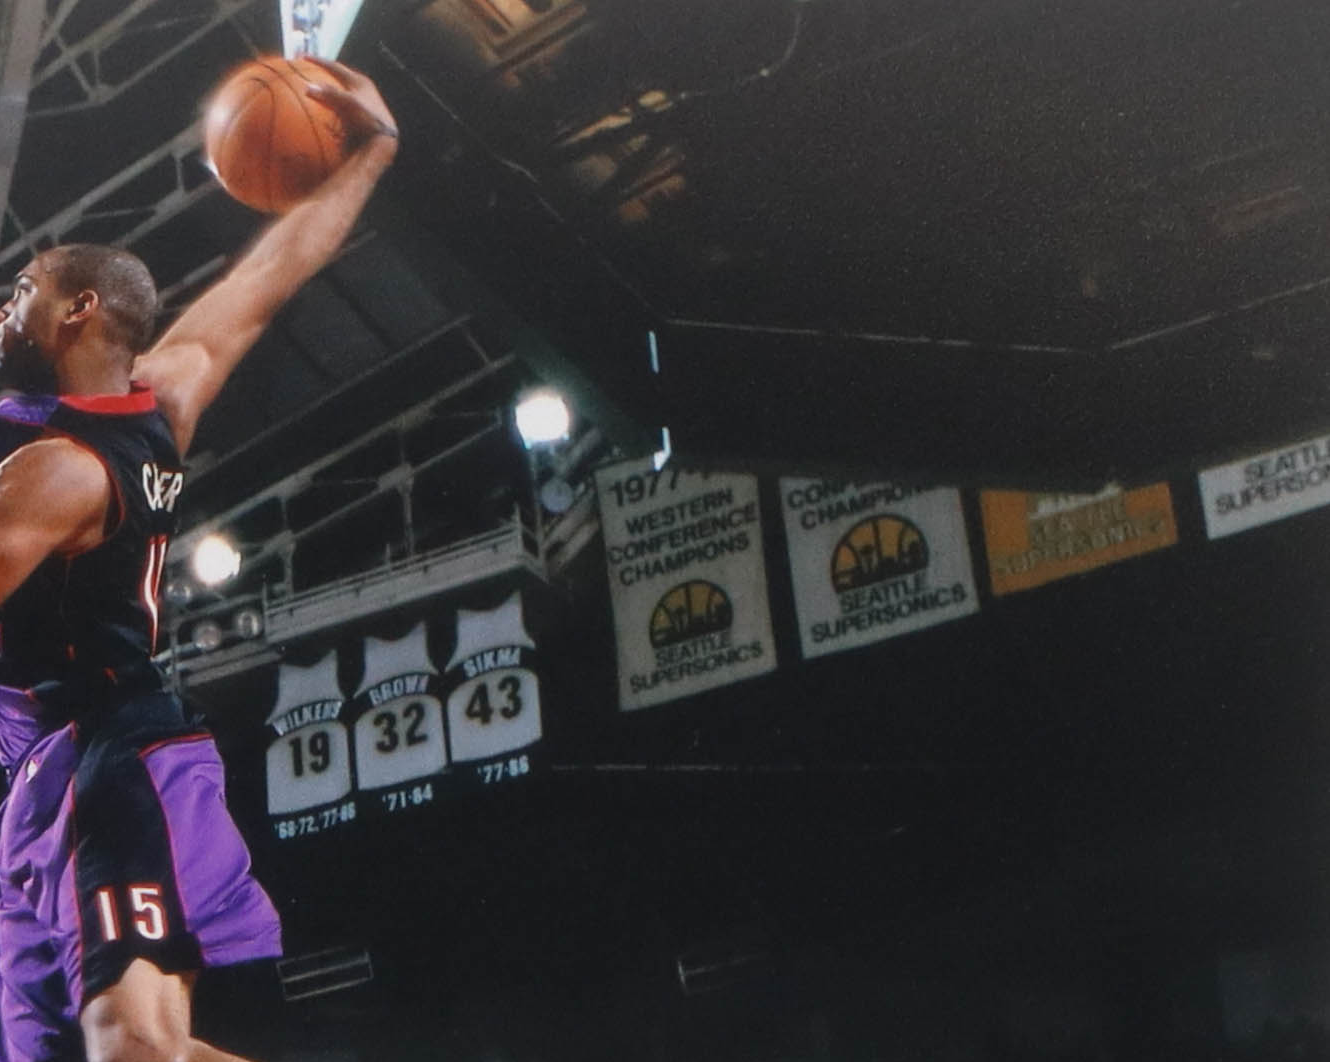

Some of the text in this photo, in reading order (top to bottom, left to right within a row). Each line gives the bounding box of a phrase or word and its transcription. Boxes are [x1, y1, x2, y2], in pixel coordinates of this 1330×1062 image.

[609, 503, 758, 565] CONFERENCE
[625, 487, 734, 534] WESTERN
[620, 531, 750, 586] CHAMPIONS
[811, 583, 968, 643] SUPERSONICS
[840, 572, 929, 613] SEATTLE
[463, 648, 521, 678] SIKMA
[630, 640, 763, 694] SUPERSONICS
[655, 631, 728, 667] SEATTLE
[370, 675, 429, 705] BROWN
[466, 676, 522, 724] 43
[272, 700, 342, 736] WILKENS
[373, 703, 428, 753] 32
[289, 732, 330, 777] 19
[97, 884, 167, 941] 15
